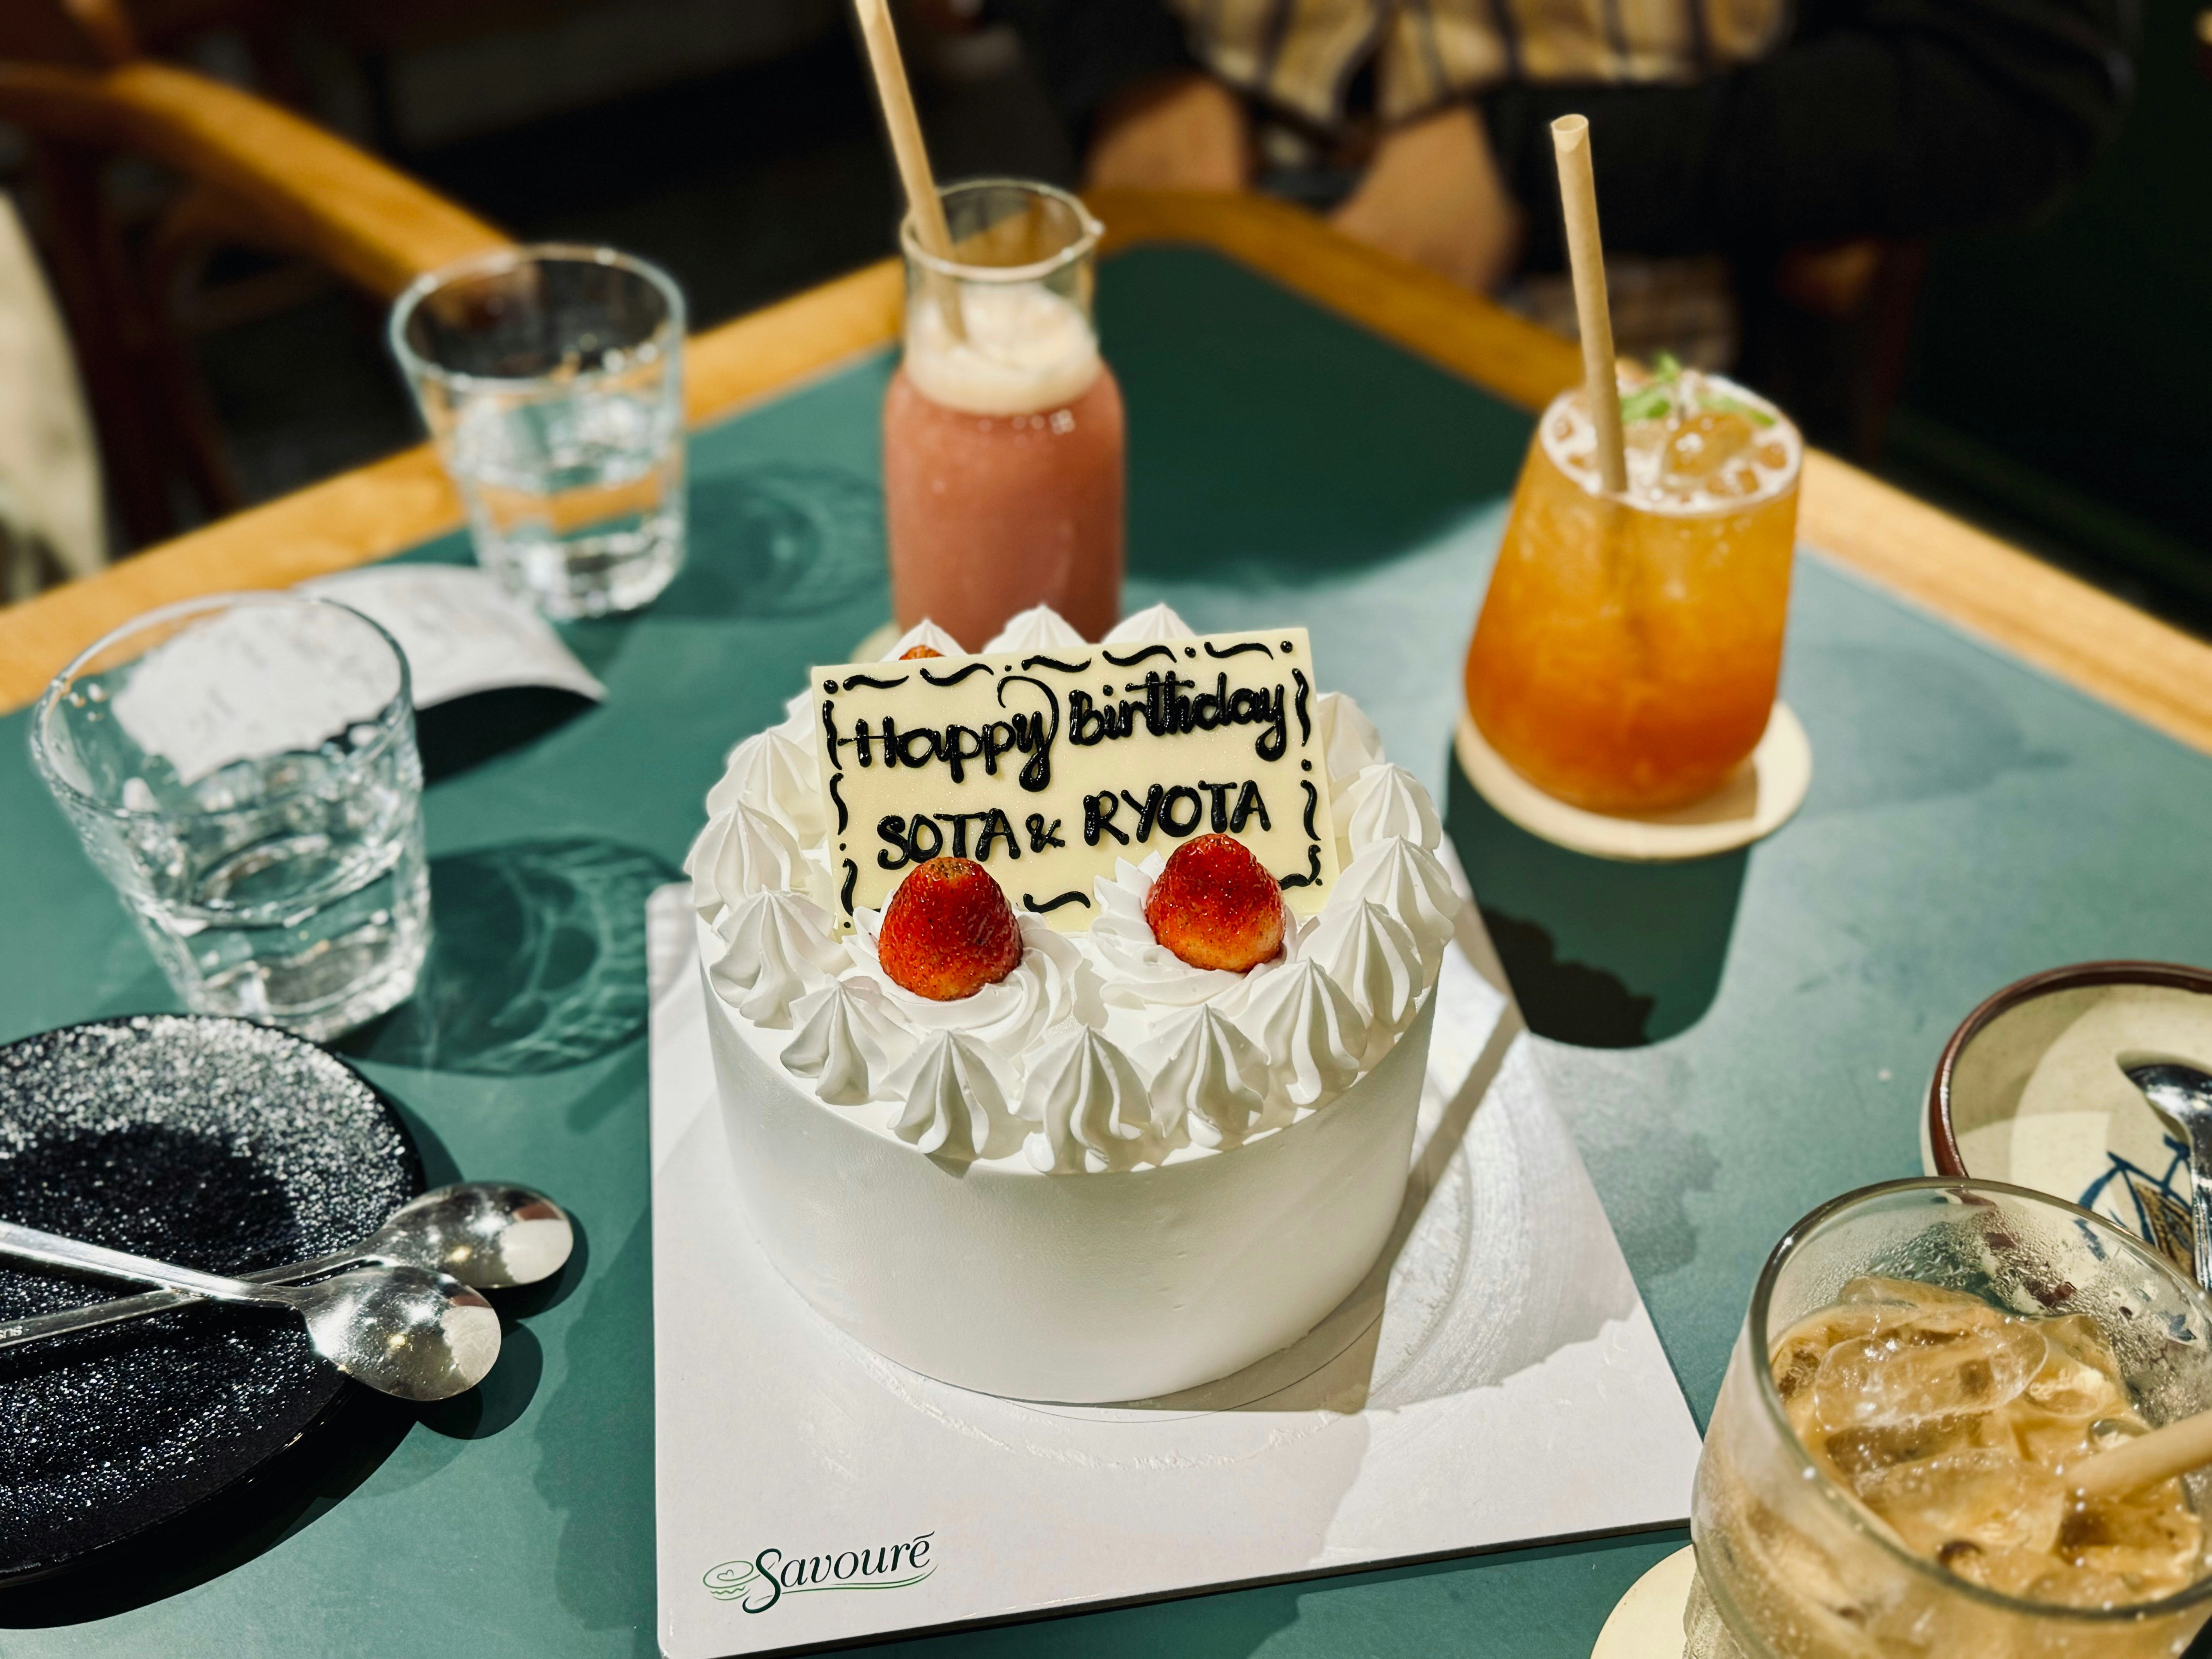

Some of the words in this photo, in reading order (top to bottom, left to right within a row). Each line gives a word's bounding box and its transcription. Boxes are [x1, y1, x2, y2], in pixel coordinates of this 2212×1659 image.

[837, 676, 1059, 792] Happy
[1069, 671, 1286, 762] Birthday
[877, 808, 1021, 870] SOTA
[1025, 814, 1065, 853] &
[1083, 780, 1271, 846] RYOTA
